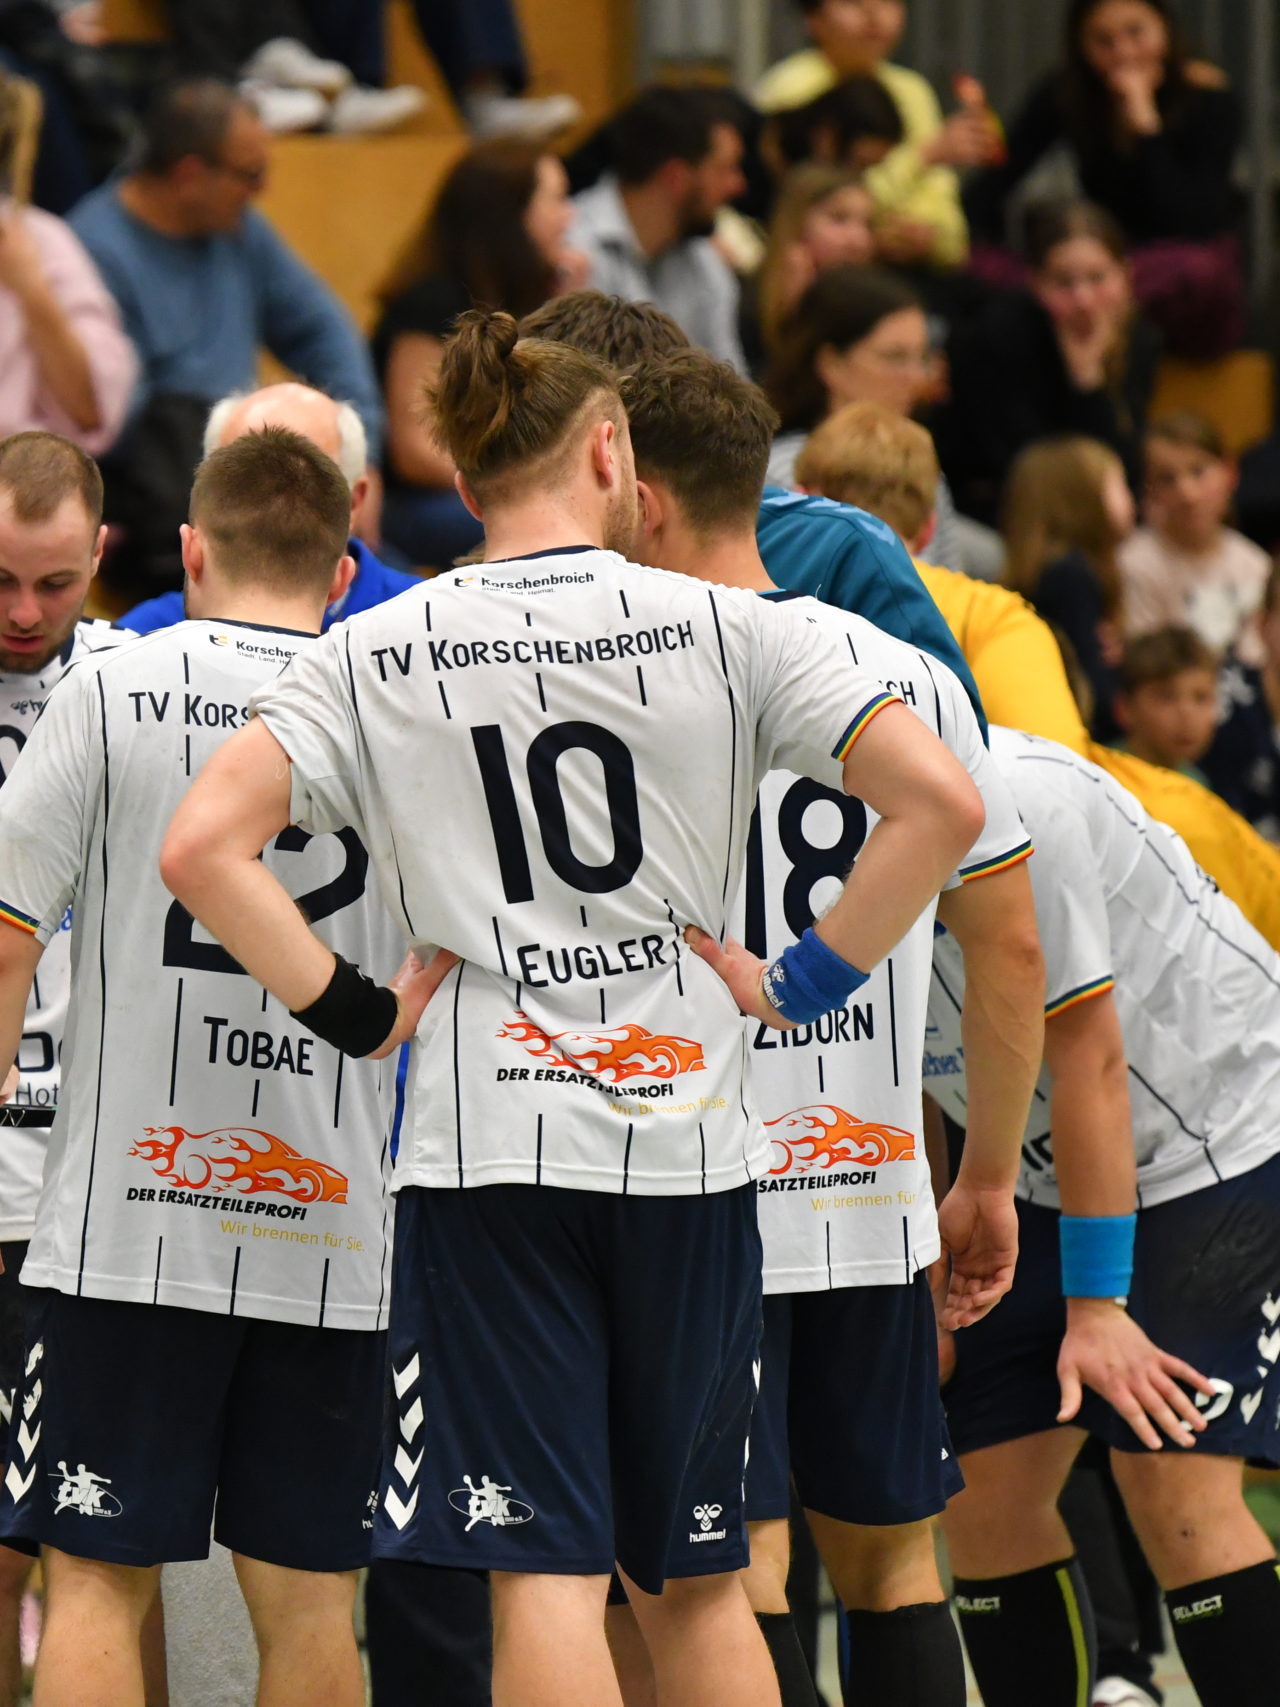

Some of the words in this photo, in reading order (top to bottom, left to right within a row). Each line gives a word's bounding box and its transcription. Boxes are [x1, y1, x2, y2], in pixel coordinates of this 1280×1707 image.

[236, 640, 298, 659] Korsche
[371, 642, 412, 682] TV
[428, 619, 695, 672] KORSCHENBROICH
[128, 691, 171, 723] TV
[185, 693, 250, 730] KORS
[470, 720, 644, 905] 10
[745, 776, 867, 960] 18
[517, 934, 668, 988] EUGLER
[203, 1016, 314, 1076] TOBAE
[497, 1068, 529, 1082] DER
[757, 1170, 877, 1194] SATZTEILEPROFI
[126, 1187, 156, 1202] DER
[158, 1189, 308, 1221] ERSATZTEILEPROFI
[833, 1192, 893, 1210] brennen
[221, 1219, 247, 1236] Wir
[252, 1223, 319, 1246] brennen
[323, 1232, 344, 1250] für
[689, 1528, 727, 1544] hummel
